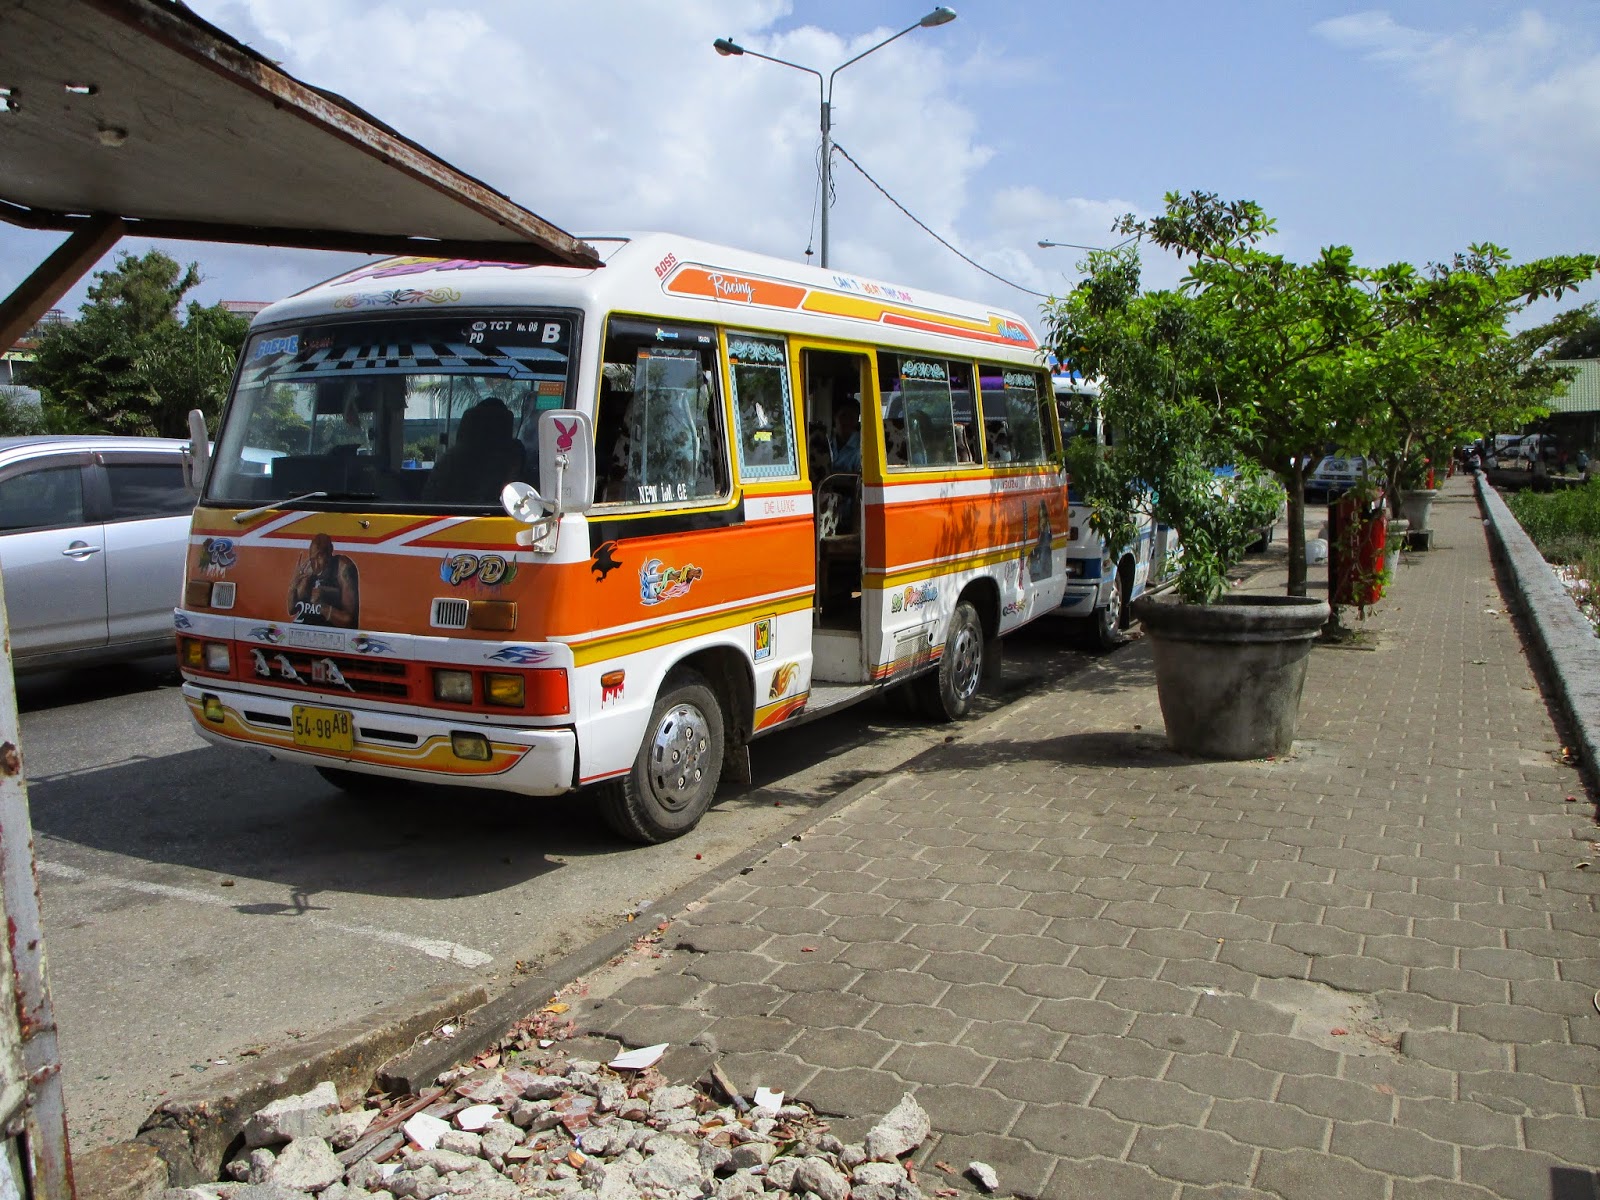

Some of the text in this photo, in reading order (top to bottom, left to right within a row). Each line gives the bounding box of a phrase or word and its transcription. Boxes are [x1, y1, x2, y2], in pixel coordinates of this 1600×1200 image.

[654, 252, 677, 278] BOSS
[707, 272, 756, 305] Racing
[469, 332, 485, 344] PD
[489, 321, 513, 331] TCT
[528, 321, 539, 332] 08
[541, 322, 562, 343] B
[450, 553, 508, 586] PD
[292, 600, 322, 624] 2PAC
